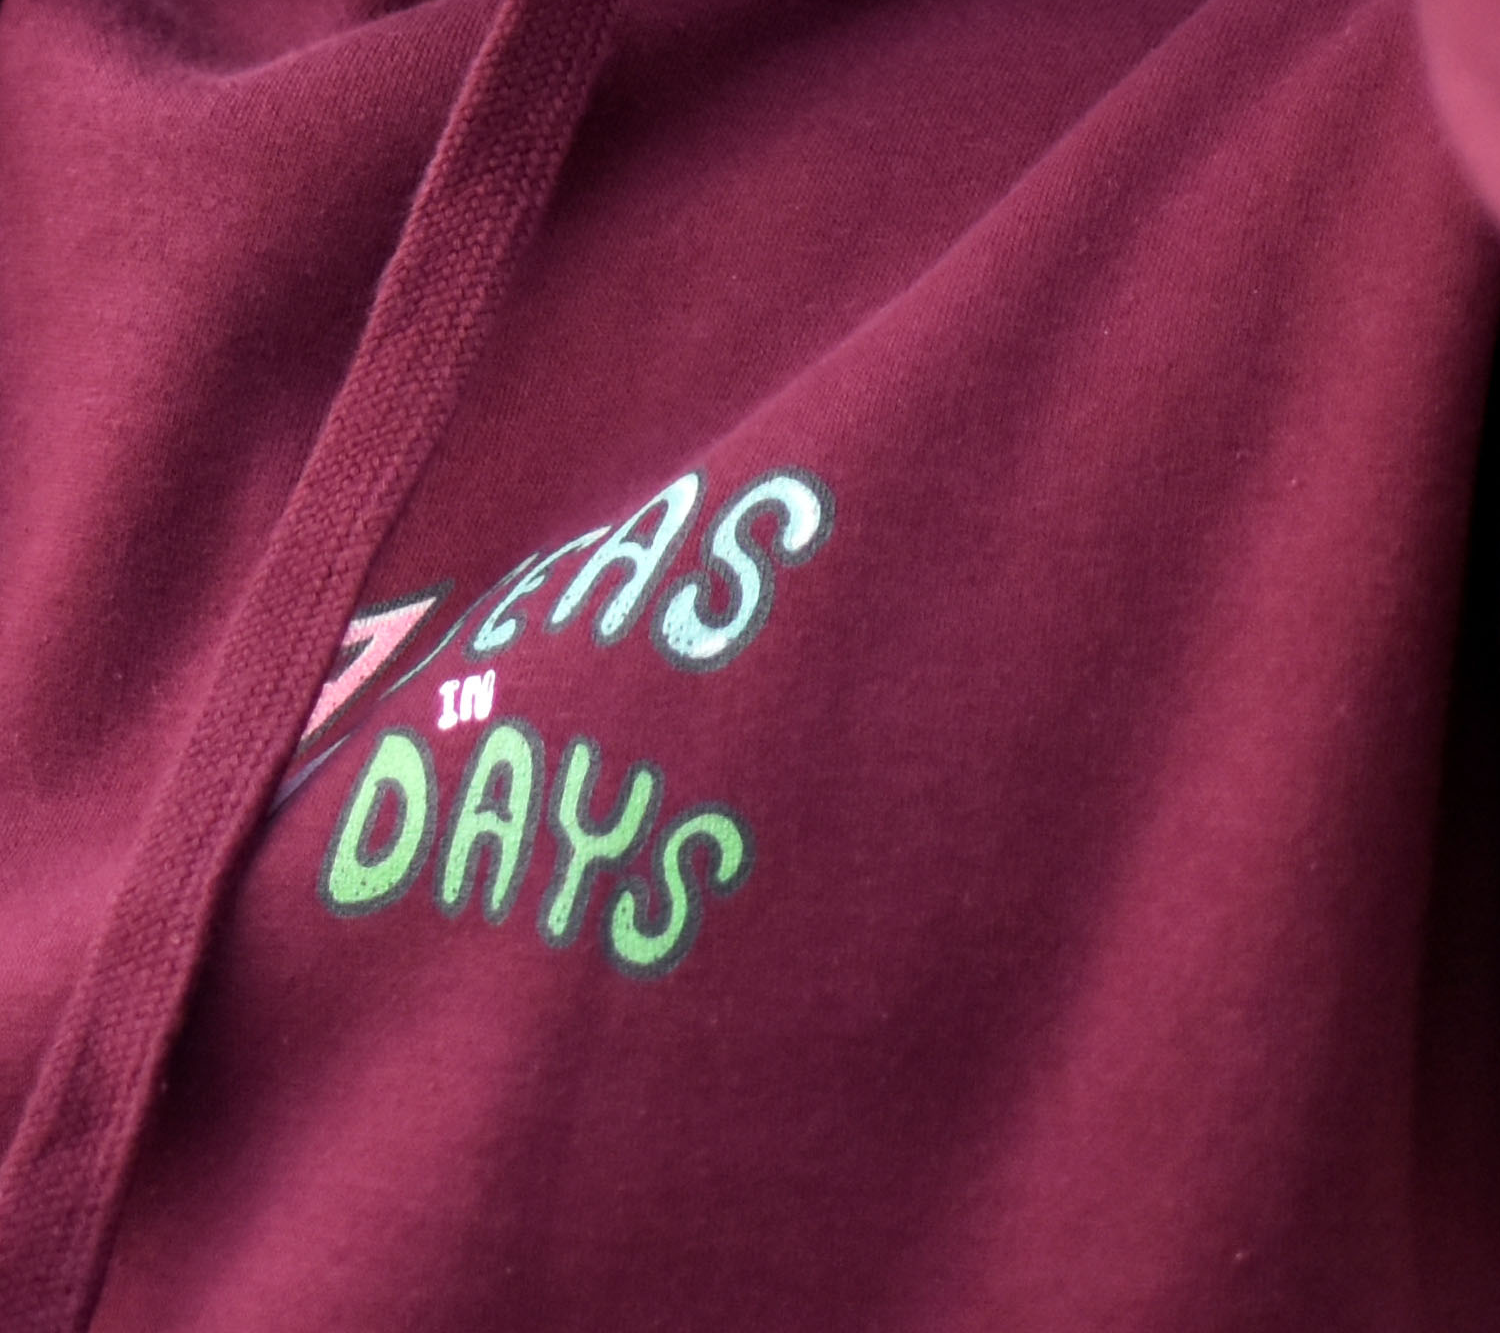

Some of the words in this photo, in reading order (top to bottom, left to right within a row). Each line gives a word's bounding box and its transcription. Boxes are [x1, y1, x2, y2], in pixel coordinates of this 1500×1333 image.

[385, 466, 836, 701] EAS
[437, 669, 496, 730] IN
[319, 716, 755, 981] DAYS
